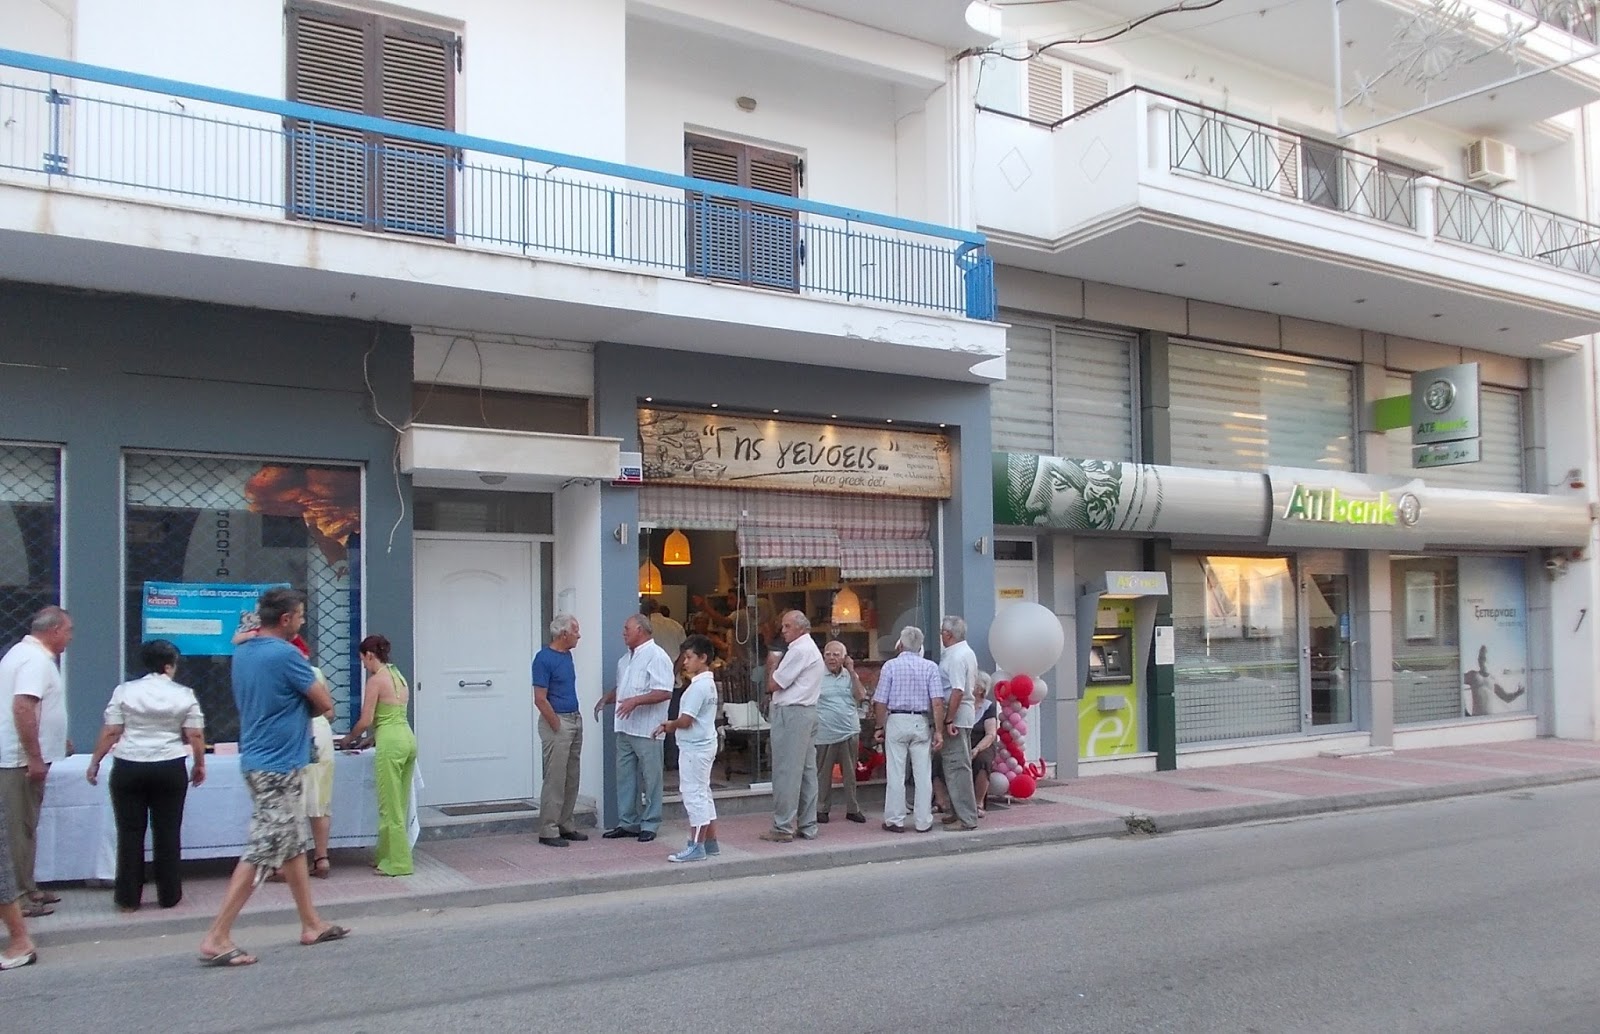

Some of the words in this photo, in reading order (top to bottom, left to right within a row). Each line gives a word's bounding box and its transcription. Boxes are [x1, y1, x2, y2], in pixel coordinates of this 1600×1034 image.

[812, 474, 836, 487] pure
[839, 475, 866, 488] greek
[868, 475, 888, 487] deli
